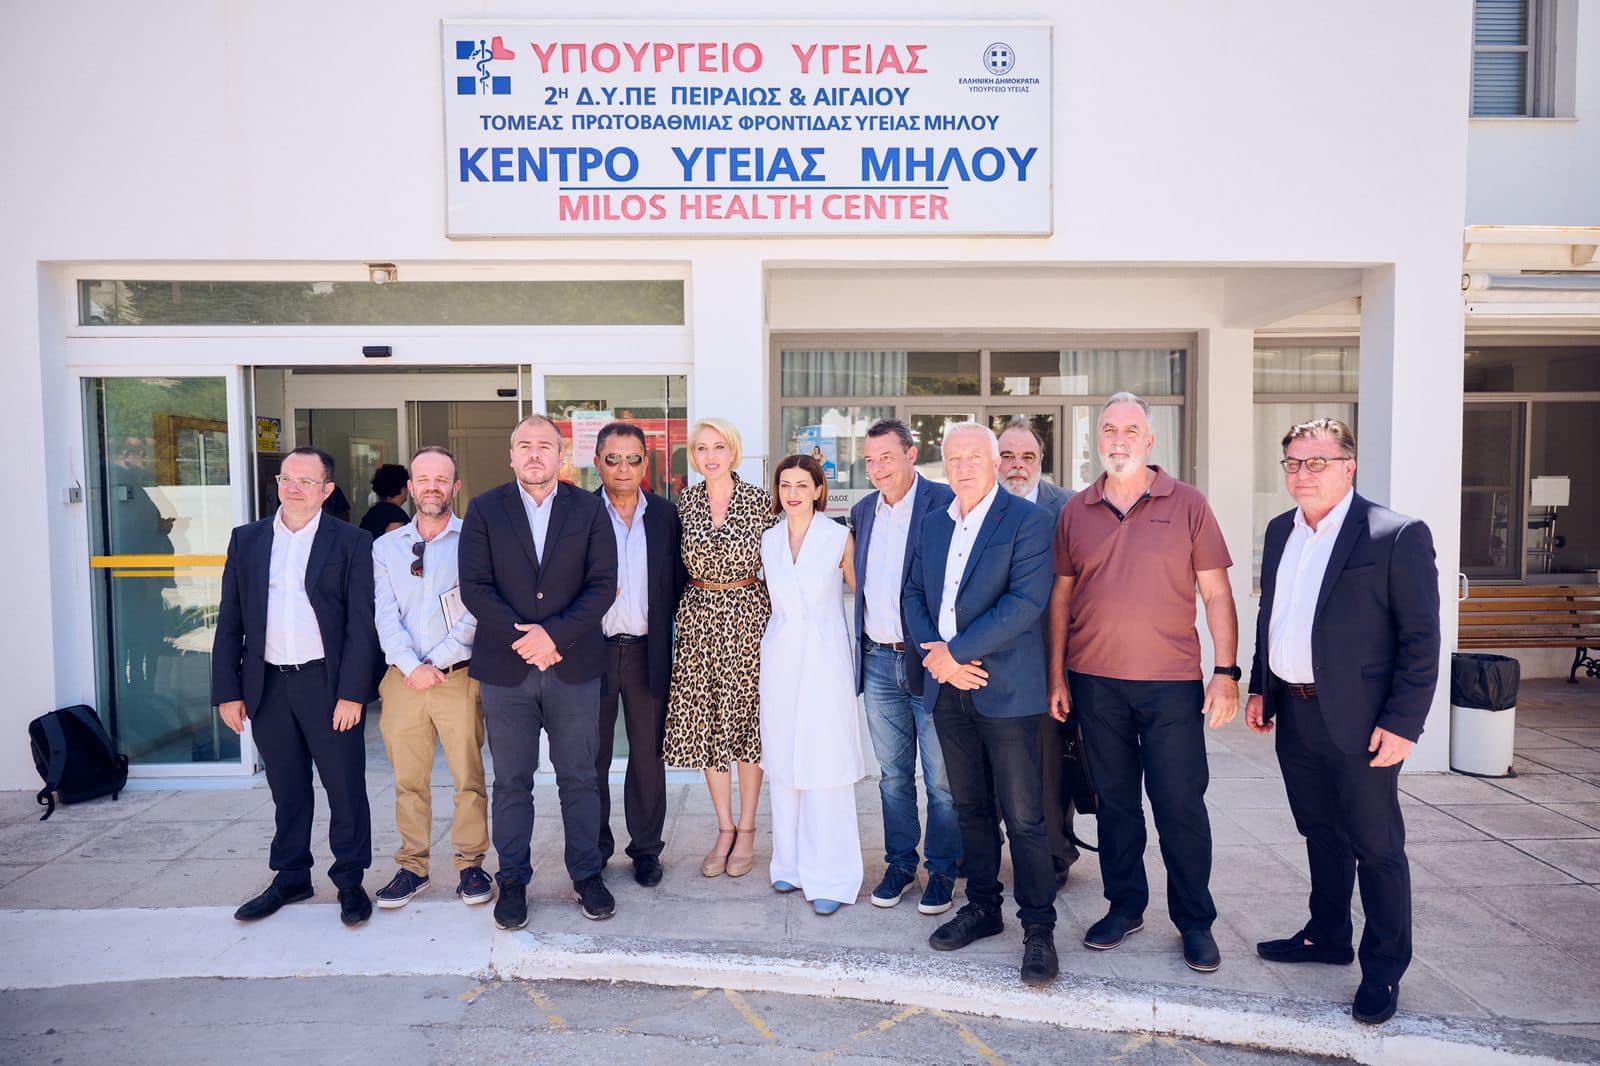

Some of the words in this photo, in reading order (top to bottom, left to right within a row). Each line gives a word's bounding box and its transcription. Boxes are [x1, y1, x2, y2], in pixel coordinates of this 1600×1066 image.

[530, 42, 763, 74] ΥΠΟΥΡΓΕΙΟ
[791, 43, 929, 75] ΥΓΕΙΑΣ
[958, 77, 994, 85] ΕΛΛΗΝΙΚΗ
[995, 77, 1040, 85] ΔΗΜΟΚΡΑΤΙΑ
[544, 86, 569, 106] 2Η
[575, 86, 657, 106] Δ.Υ.ΠΕ
[671, 86, 782, 106] ΠΕΙΡΑΙΩΣ
[788, 86, 807, 107] &
[812, 86, 911, 106] ΑΙΓΑΙΟΥ
[480, 114, 564, 131] ΤΟΜΕΑΣ
[571, 114, 733, 131] ΠΡΩΤΟΒΑΘΜΙΑΣ
[738, 114, 853, 131] ΦΡΟΝΤΙΔΑΣ
[855, 114, 921, 131] ΥΓΕΙΑΣ
[924, 114, 1001, 131] ΜΗΛΟΥ
[459, 146, 640, 183] ΚΕΝΤΡΟ
[670, 146, 827, 183] ΥΓΕΙΑΣ
[860, 146, 1039, 183] ΜΗΛΟΥ
[558, 194, 667, 222] MILOS
[679, 193, 812, 221] HEALTH
[821, 193, 949, 221] CENTER
[828, 494, 849, 503] ΟΔΟΣ
